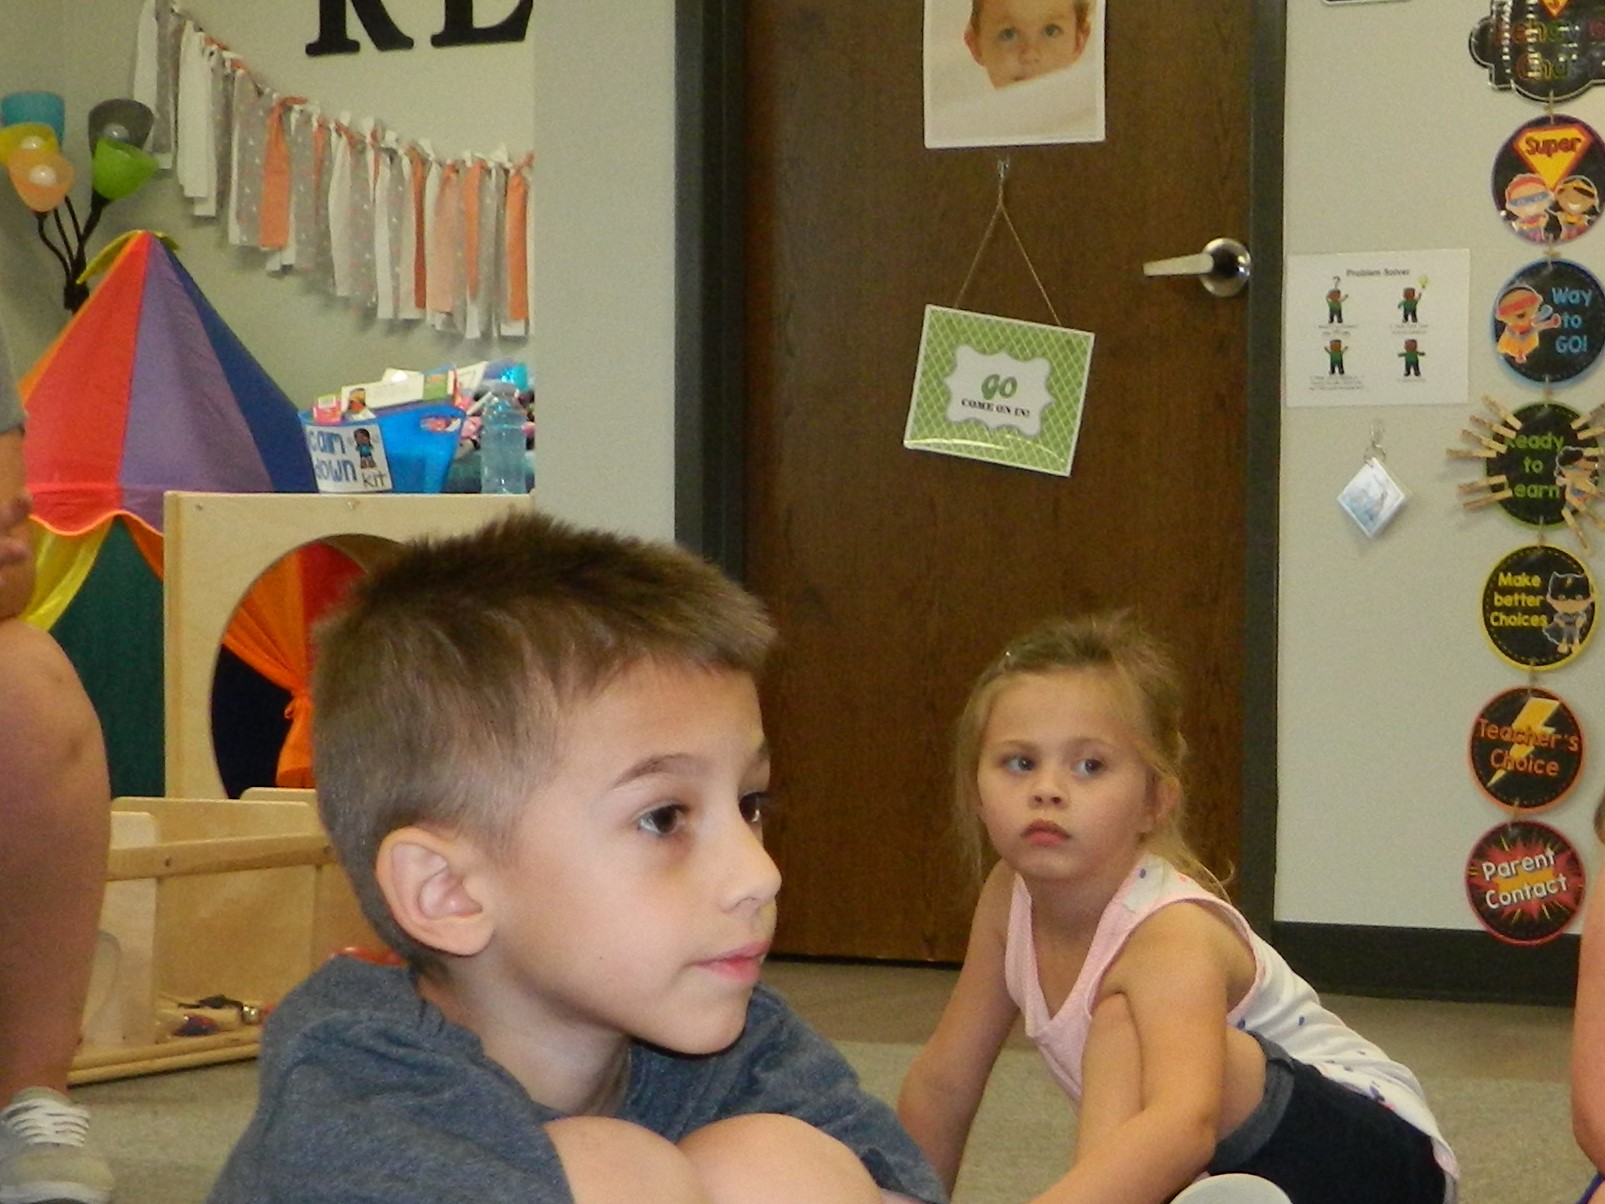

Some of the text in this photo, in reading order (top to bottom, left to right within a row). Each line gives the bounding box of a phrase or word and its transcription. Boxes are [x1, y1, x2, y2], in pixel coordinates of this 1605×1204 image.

[1525, 136, 1582, 157] Super
[1551, 287, 1593, 308] Way
[1561, 312, 1583, 329] to
[1555, 334, 1588, 354] GO!
[961, 398, 995, 412] COME
[996, 404, 1012, 415] ON
[1522, 456, 1544, 474] to
[1498, 572, 1542, 588] Make
[1493, 591, 1546, 608] better
[1489, 611, 1549, 628] Choices
[1478, 718, 1580, 753] Teacher's
[1490, 748, 1561, 777] Choice
[1482, 847, 1556, 882] Parent
[1485, 873, 1568, 910] Contact
